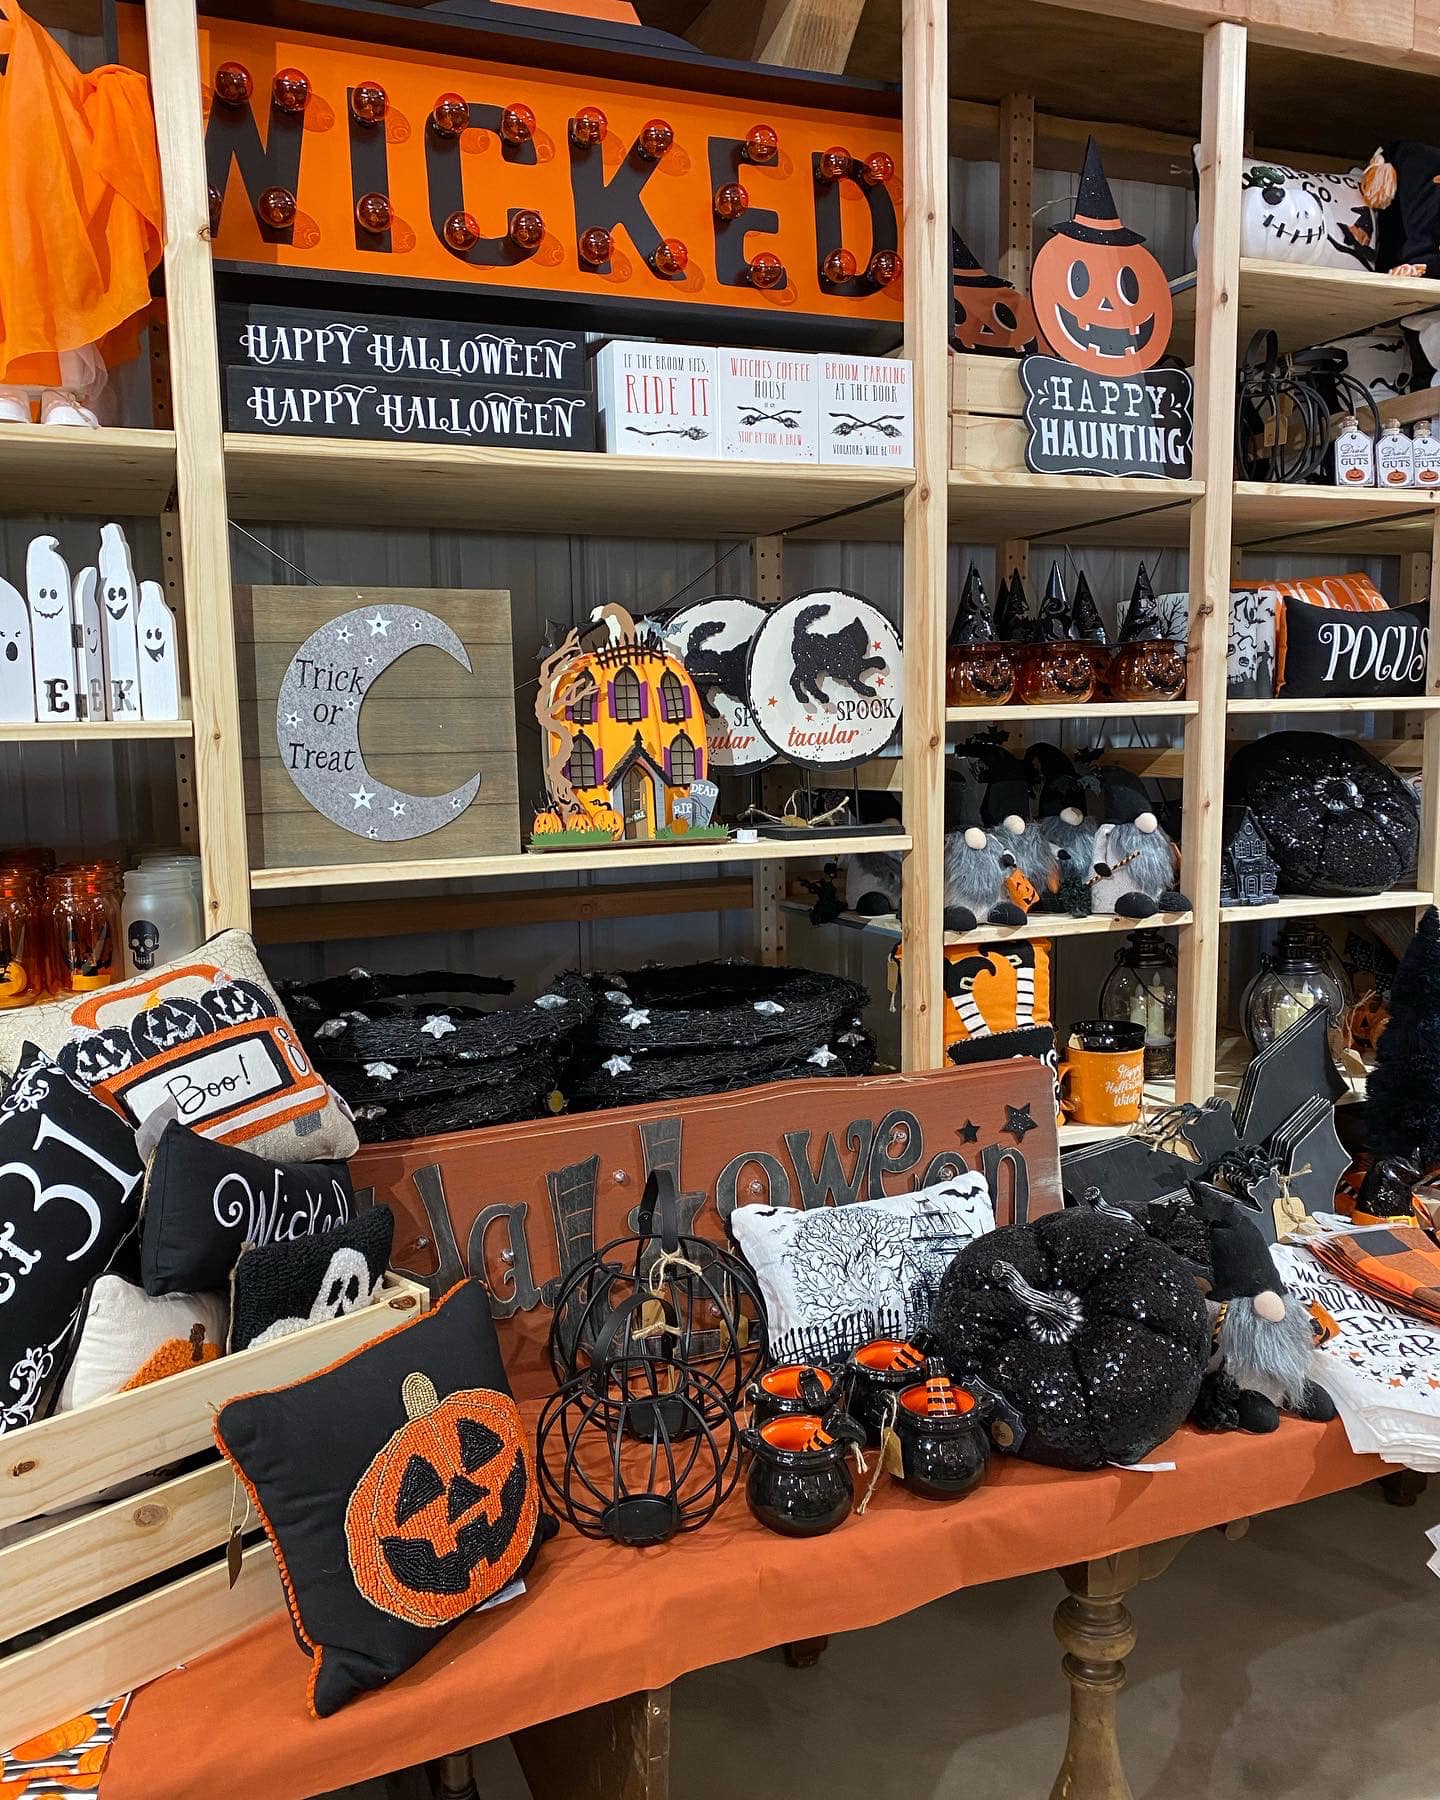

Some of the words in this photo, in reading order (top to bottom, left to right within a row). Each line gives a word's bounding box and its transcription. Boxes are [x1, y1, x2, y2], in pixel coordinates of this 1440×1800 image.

[205, 84, 903, 296] WICKED
[239, 323, 368, 365] HAPPY
[366, 333, 577, 380] HALLOWEEN
[624, 353, 633, 368] IF
[636, 354, 653, 369] THE
[655, 355, 684, 371] BROOM
[730, 358, 772, 379] WITCHES
[777, 361, 810, 381] COFFEE
[825, 362, 858, 381] BROOM
[863, 364, 906, 384] PARKING
[625, 374, 679, 416] RIDE
[690, 378, 709, 416] IT
[754, 380, 786, 400] HOUSE
[835, 383, 845, 401] AT
[850, 383, 868, 401] THE
[872, 384, 897, 403] DOOR
[1050, 376, 1167, 419] HAPPY
[246, 384, 377, 427] HAPPY
[375, 392, 586, 438] HALLOWEEN
[833, 443, 862, 456] VIOLATORS
[865, 445, 879, 456] WILL
[1039, 417, 1186, 465] HAUNTING
[1341, 457, 1369, 466] GUTS
[1382, 460, 1411, 468] GUTS
[1414, 460, 1440, 468] GUTS
[1318, 623, 1429, 682] POCUS
[296, 658, 364, 695] Trick
[313, 703, 344, 726] or
[837, 698, 896, 722] SPOOK
[706, 729, 755, 750] cular
[788, 724, 859, 747] tacular
[289, 742, 356, 772] Treat
[690, 783, 718, 797] DEAD
[673, 802, 692, 814] RIP
[164, 1054, 251, 1115] Boo!
[1336, 1314, 1426, 1337] IME
